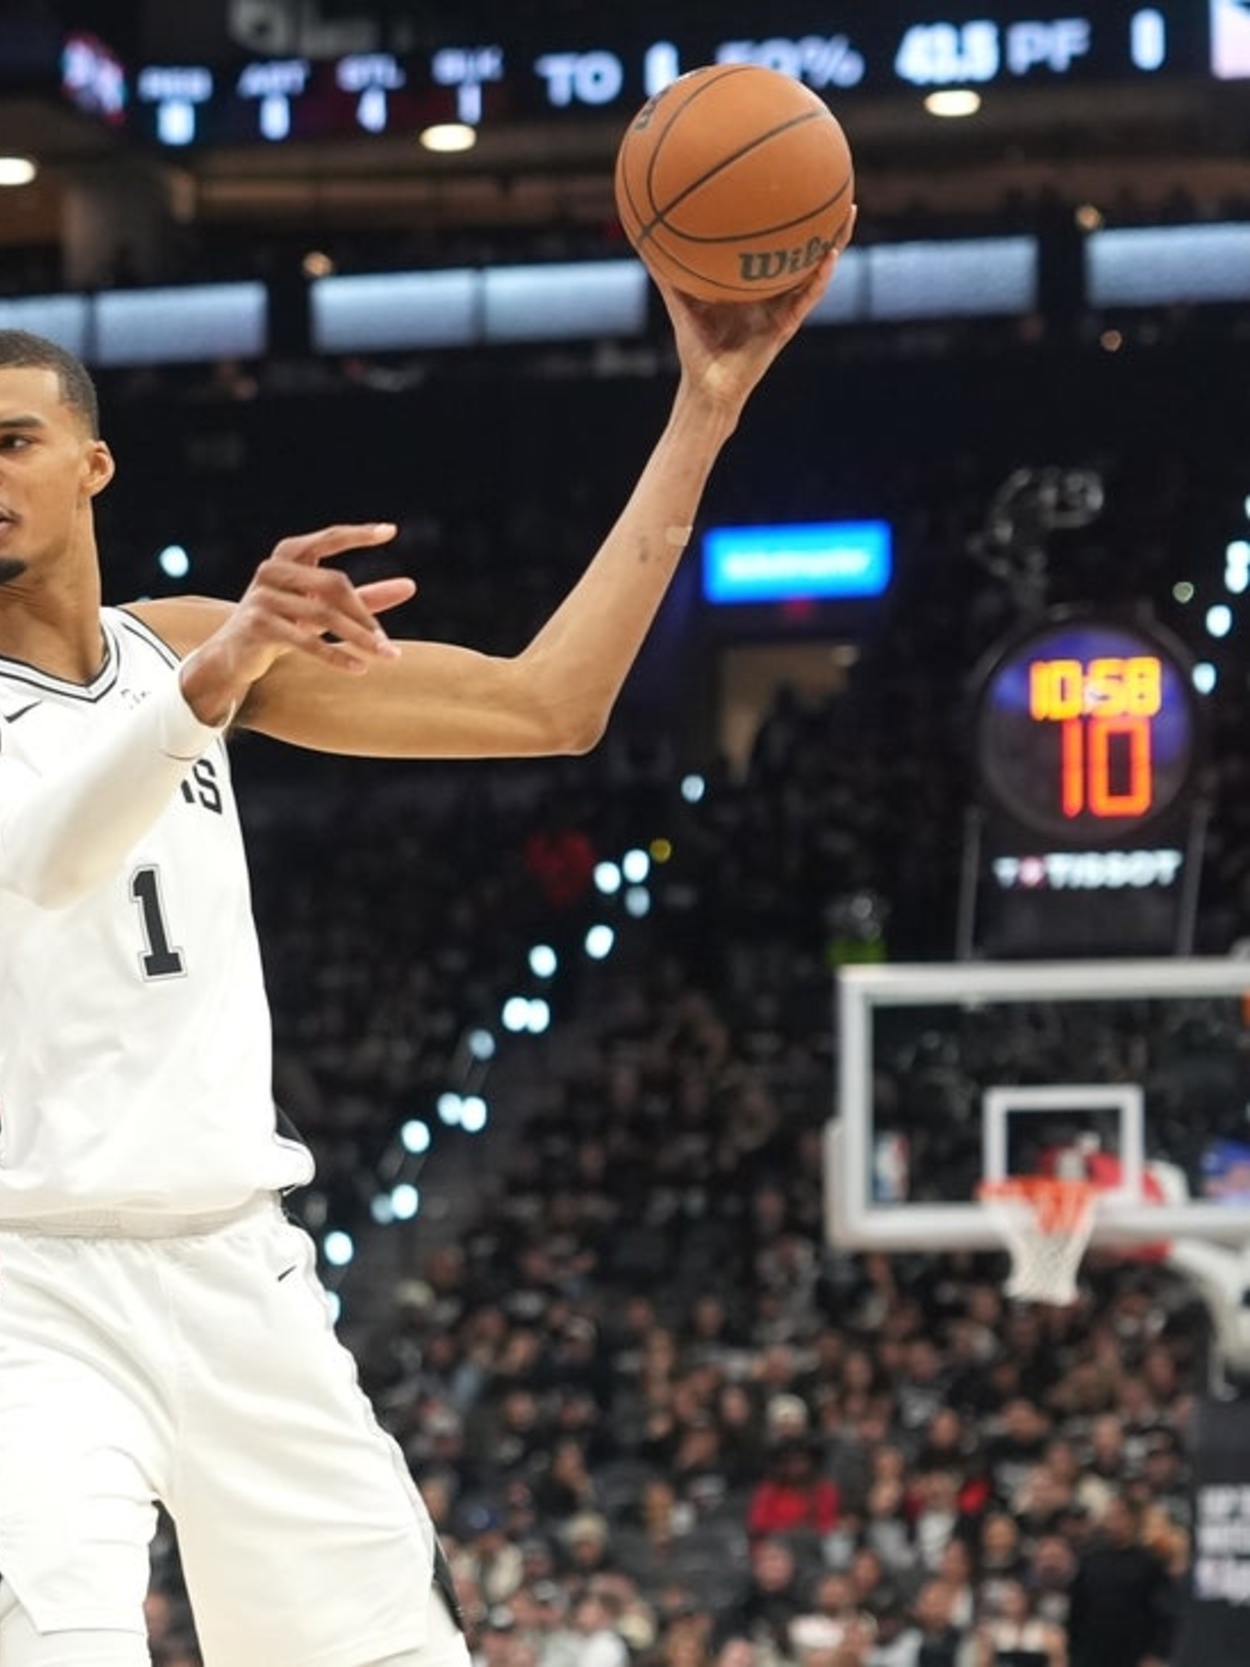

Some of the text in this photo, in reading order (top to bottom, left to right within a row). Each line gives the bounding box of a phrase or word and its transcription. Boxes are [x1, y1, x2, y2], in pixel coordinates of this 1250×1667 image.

[535, 50, 622, 106] TO
[1007, 18, 1090, 74] PF
[1062, 718, 1152, 818] 10
[130, 865, 187, 981] 1
